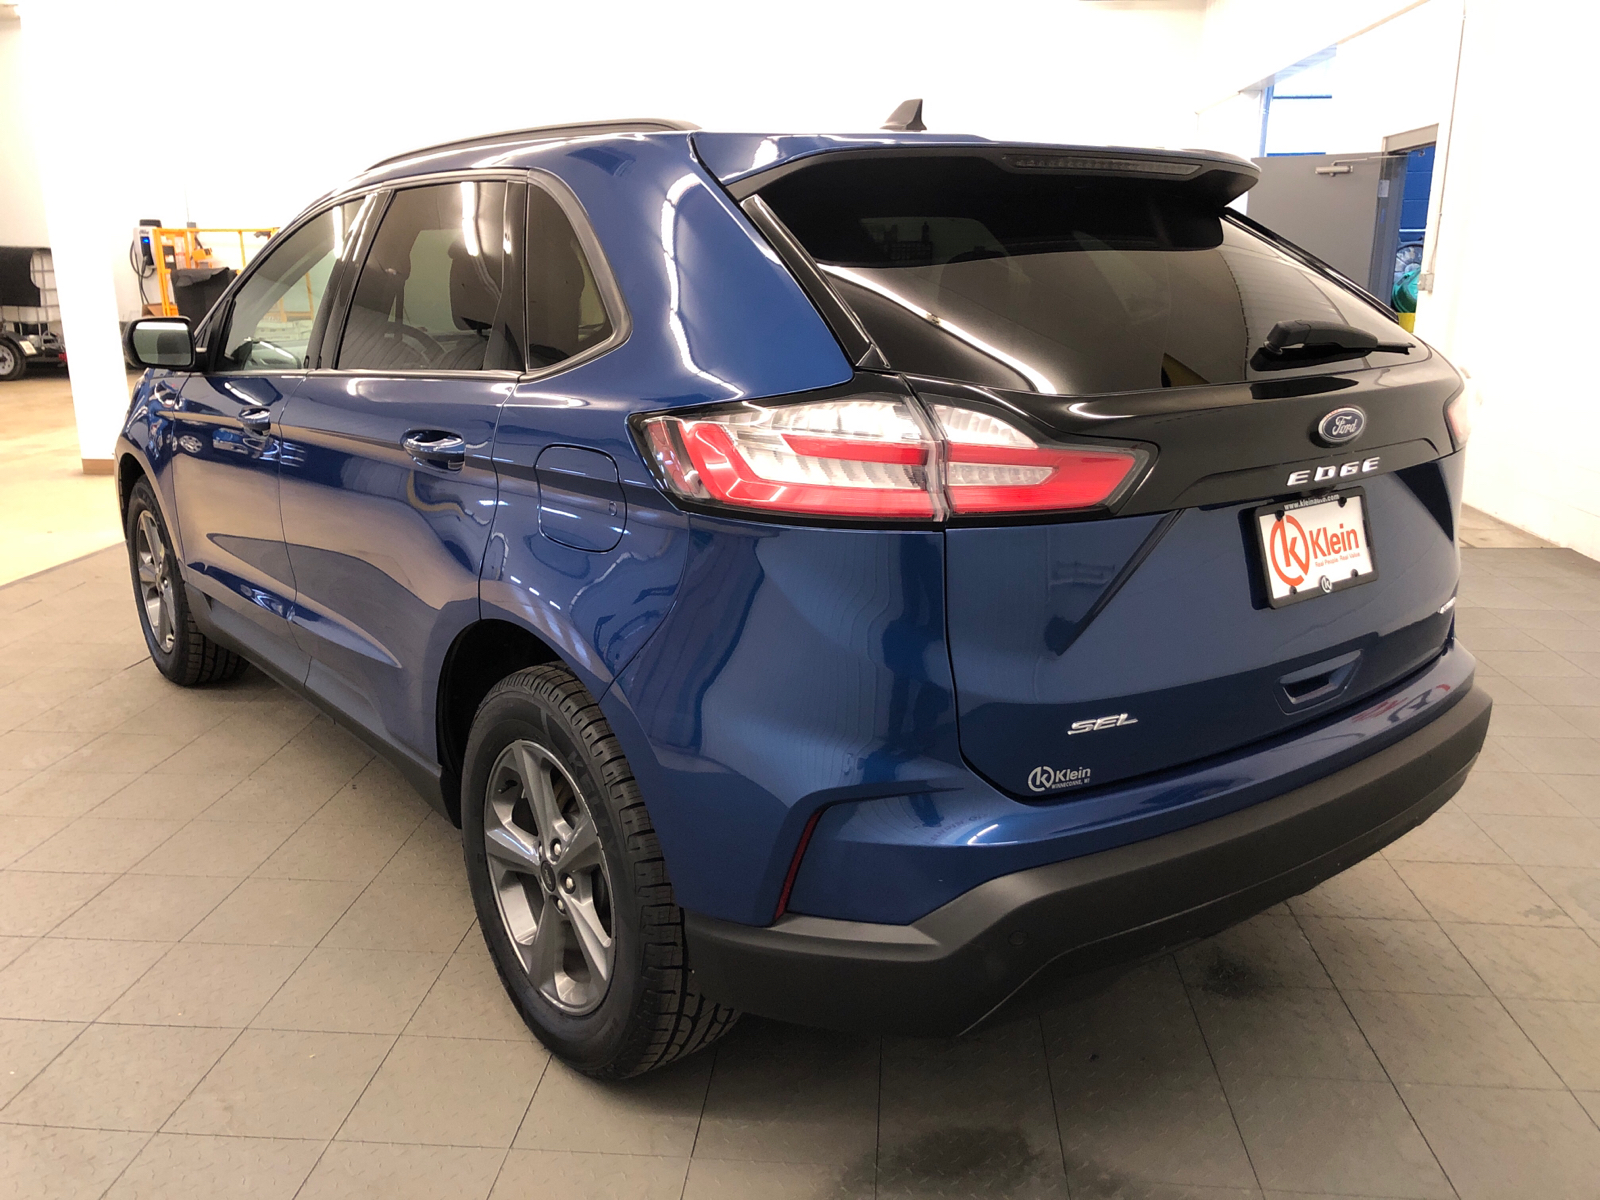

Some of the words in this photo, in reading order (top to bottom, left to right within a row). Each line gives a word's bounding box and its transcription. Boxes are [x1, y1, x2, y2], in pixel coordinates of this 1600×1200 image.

[1332, 415, 1358, 435] Ford
[1286, 457, 1380, 486] EDGE
[1284, 493, 1340, 510] www.kleinauto.com
[1309, 523, 1360, 559] Klein
[1067, 713, 1138, 735] SEL
[1055, 766, 1091, 783] Klein
